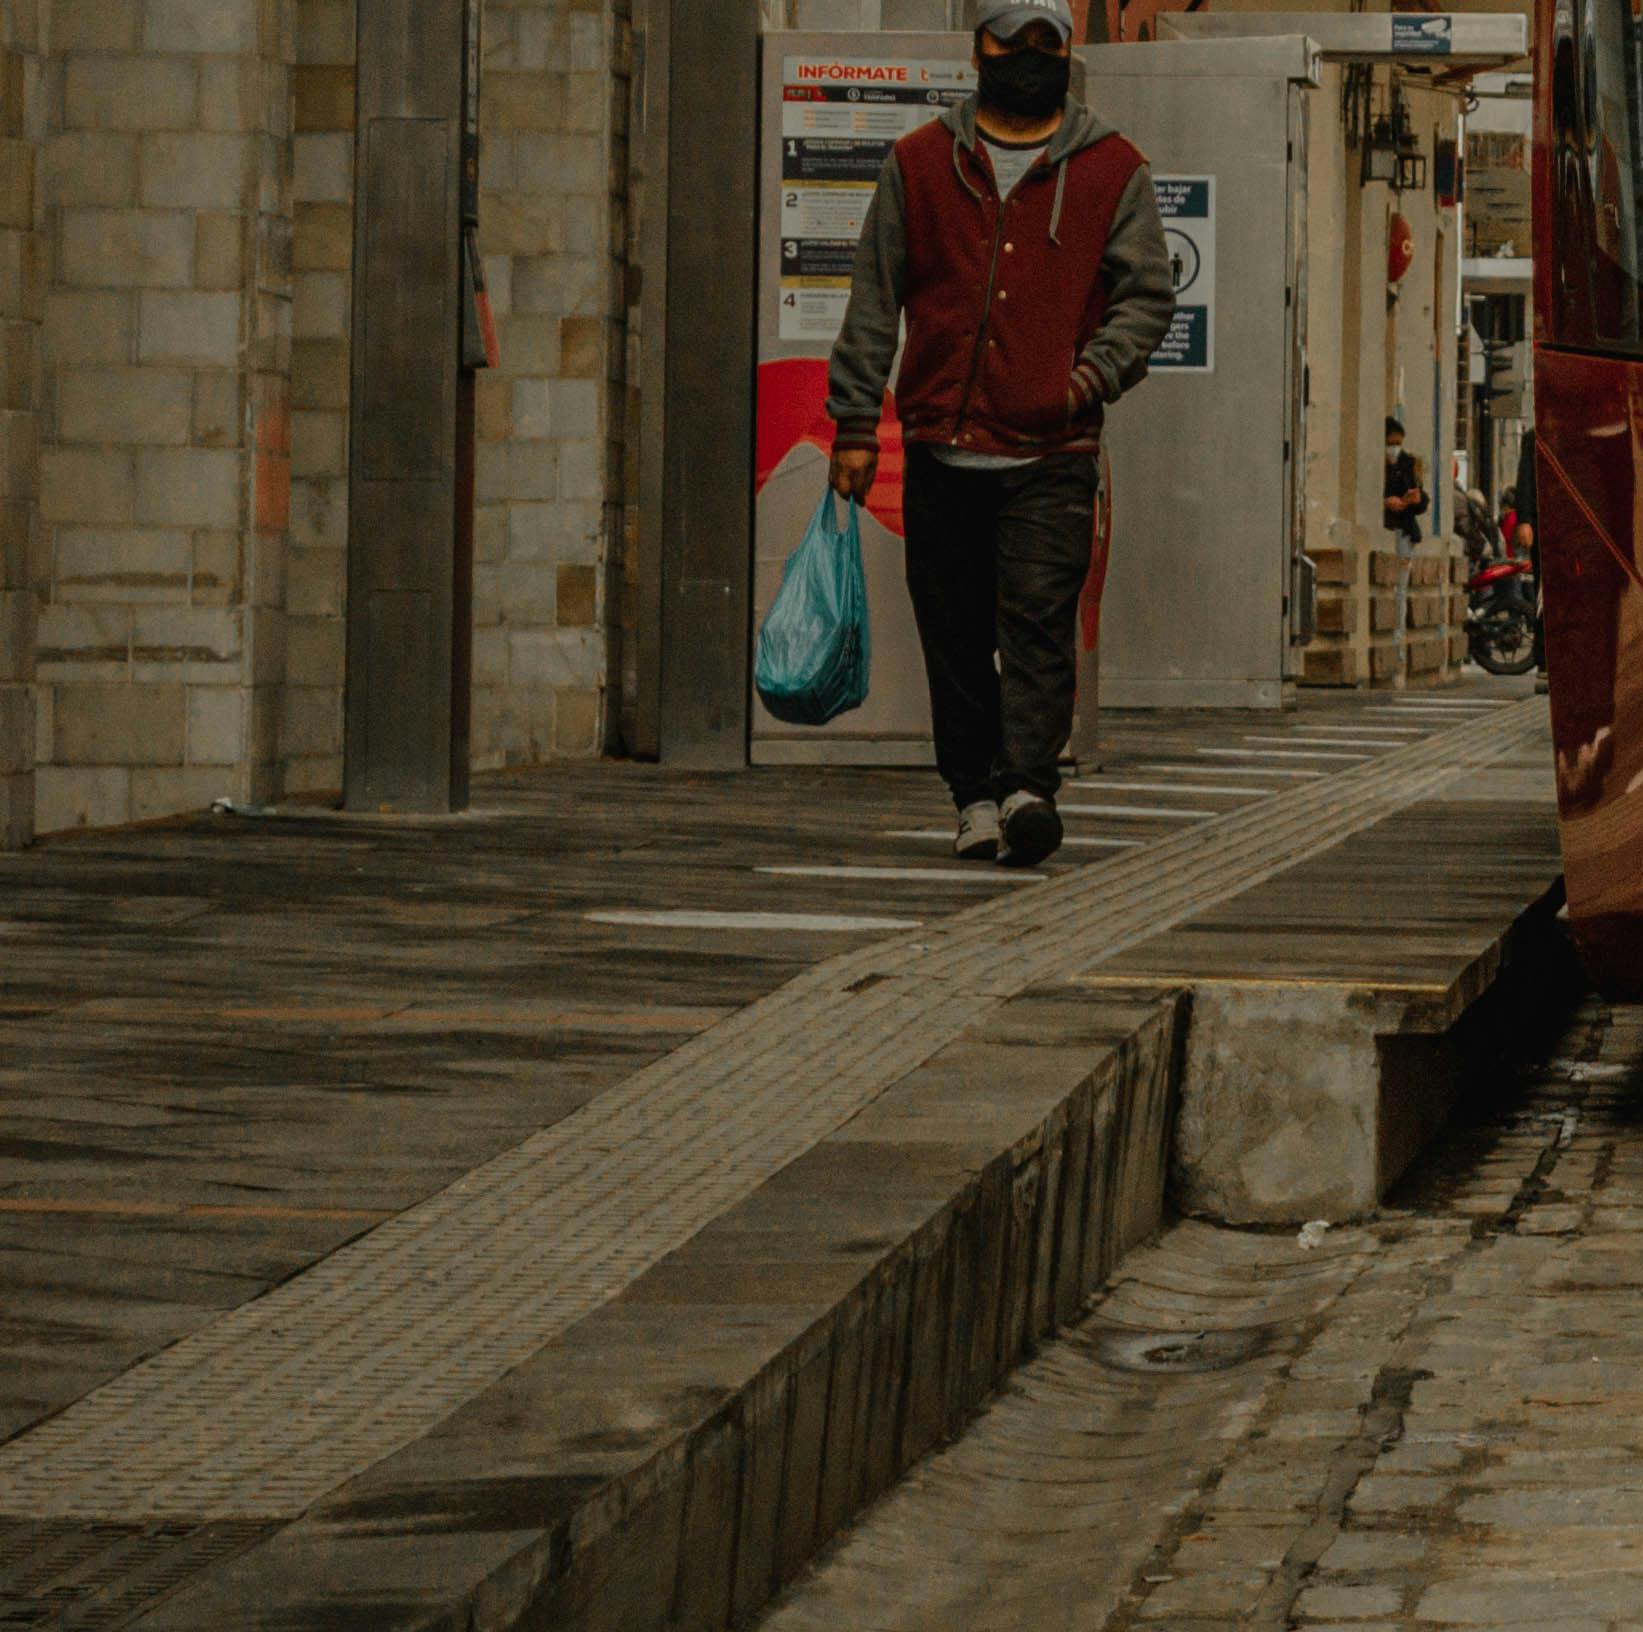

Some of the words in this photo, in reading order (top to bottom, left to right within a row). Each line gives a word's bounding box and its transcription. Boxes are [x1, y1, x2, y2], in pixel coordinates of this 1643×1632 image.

[797, 61, 908, 81] INFÓRMATE
[787, 140, 798, 157] 1
[785, 193, 798, 208] 2
[784, 241, 798, 259] 3
[783, 293, 797, 309] 4
